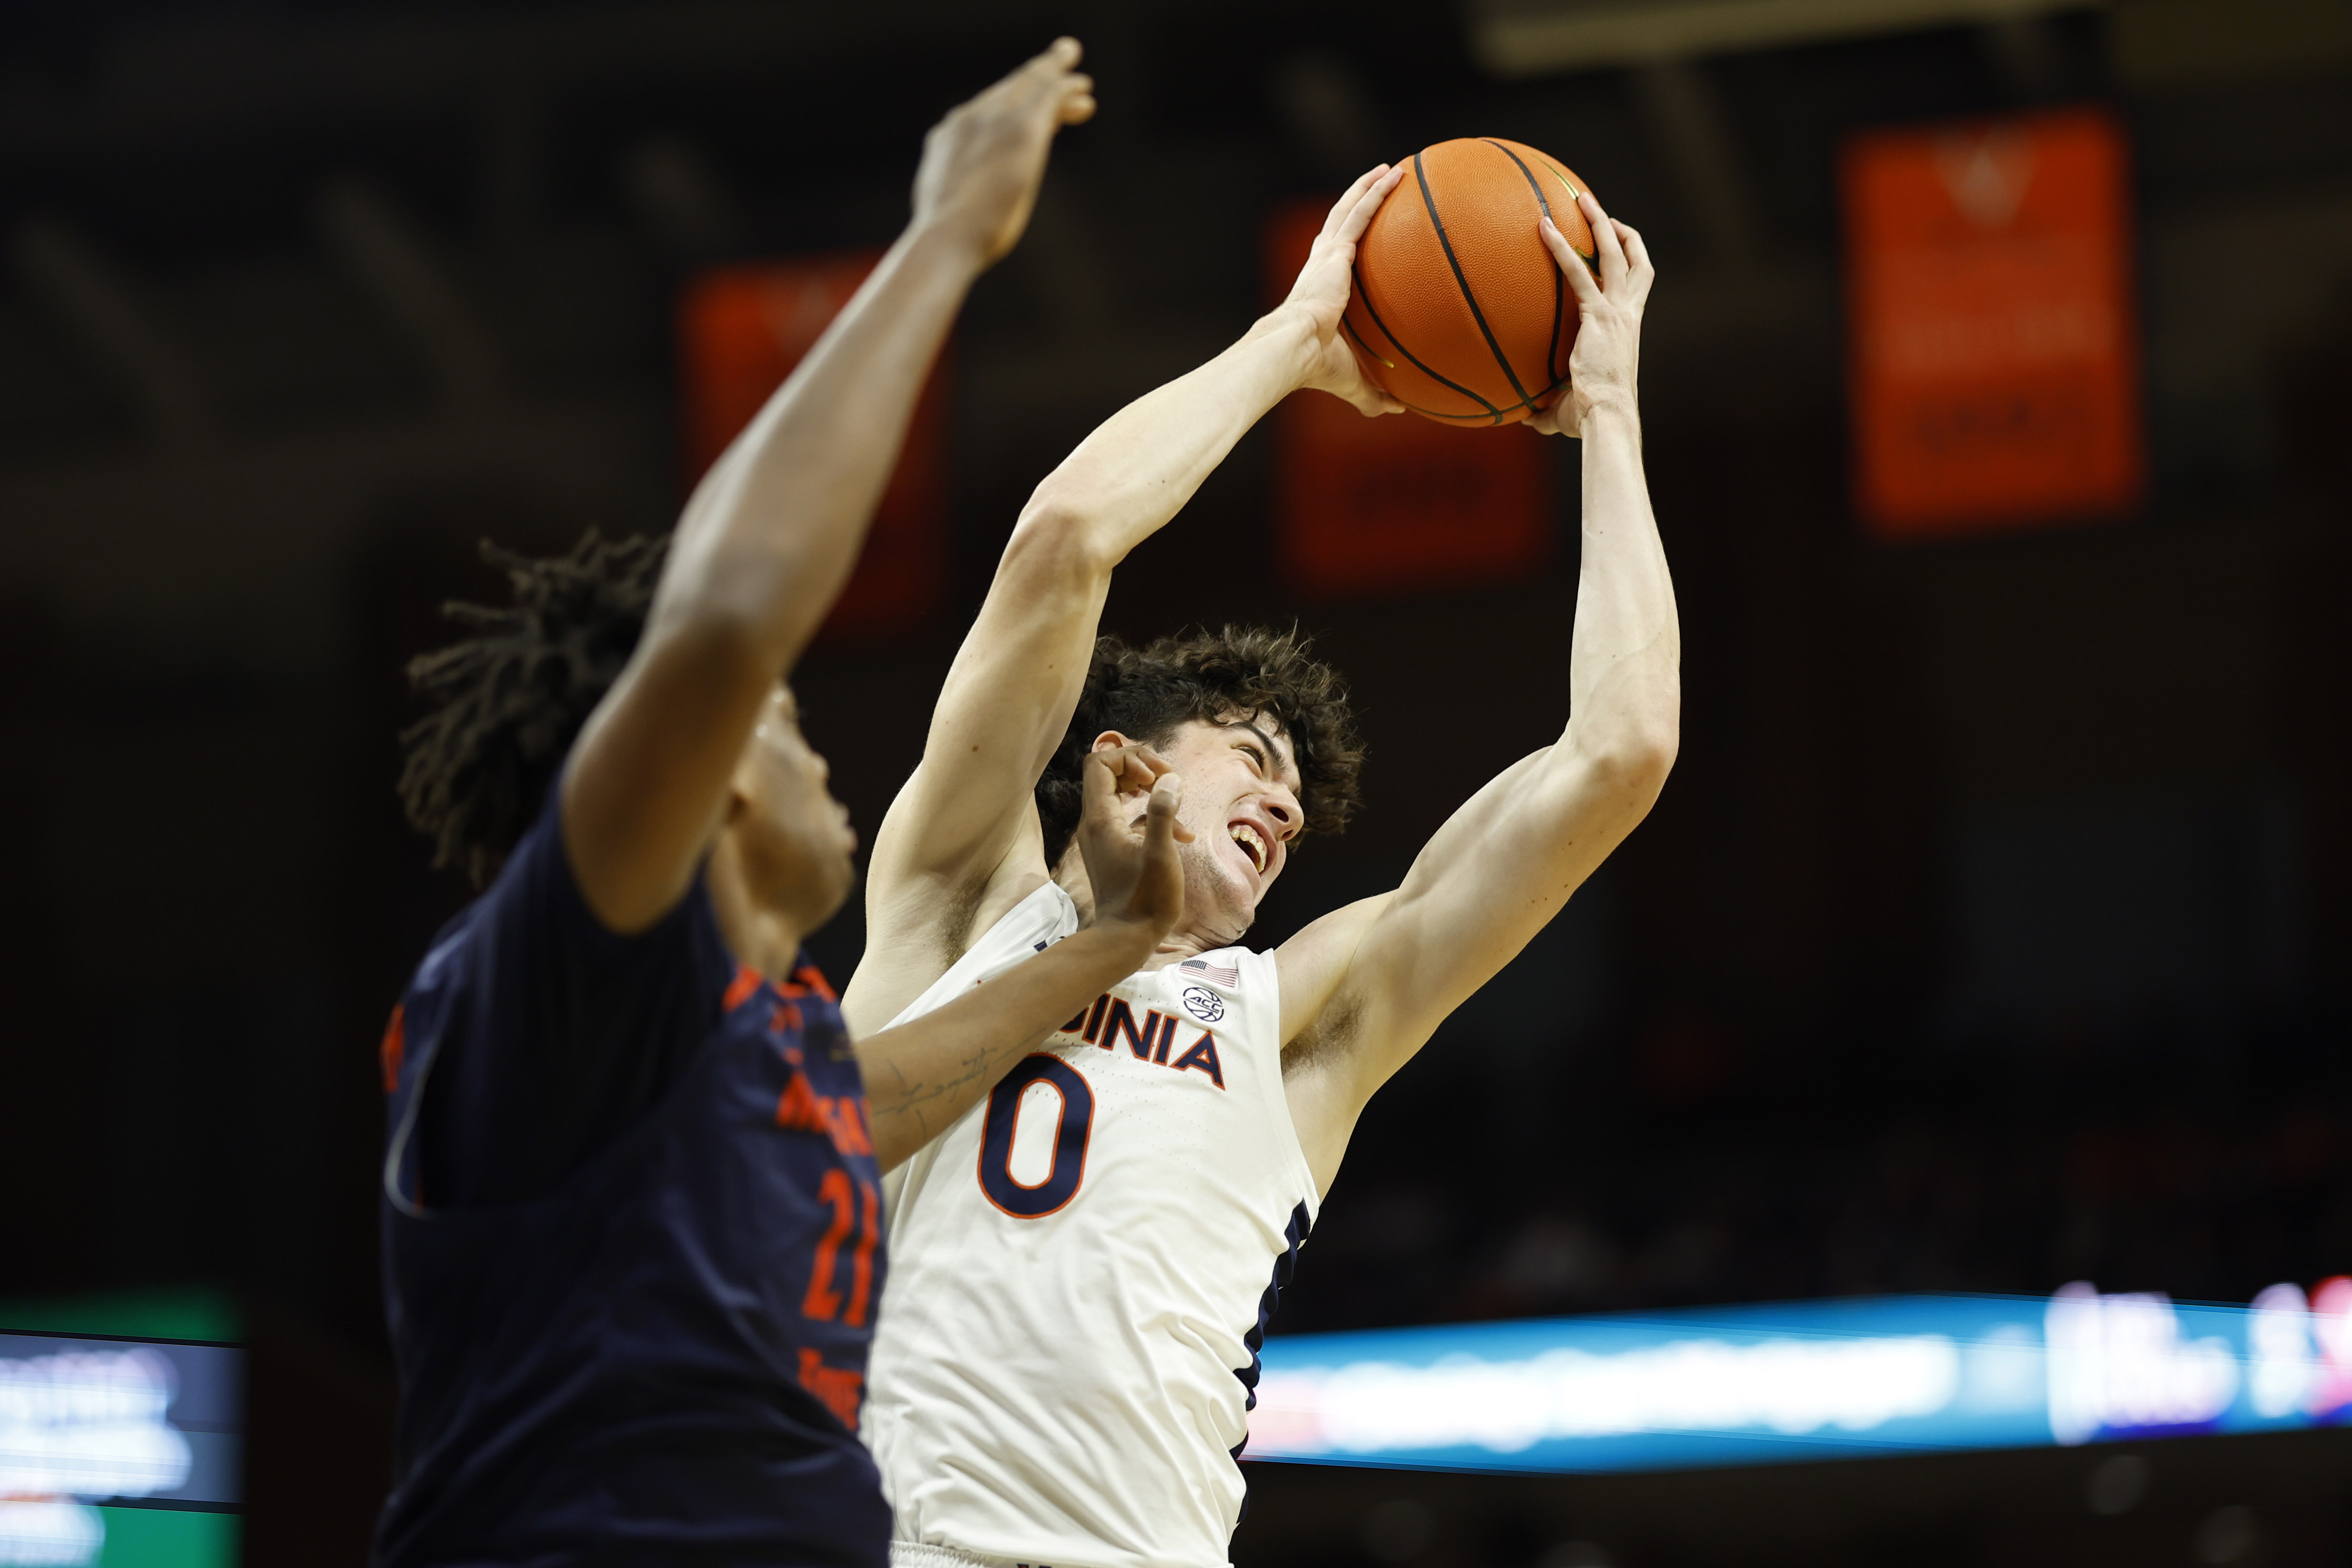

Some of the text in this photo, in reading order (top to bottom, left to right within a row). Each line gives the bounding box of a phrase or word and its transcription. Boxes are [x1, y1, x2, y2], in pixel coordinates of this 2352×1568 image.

[1188, 996, 1223, 1012] ACC
[977, 1052, 1095, 1219] 0
[801, 1167, 879, 1328] 21
